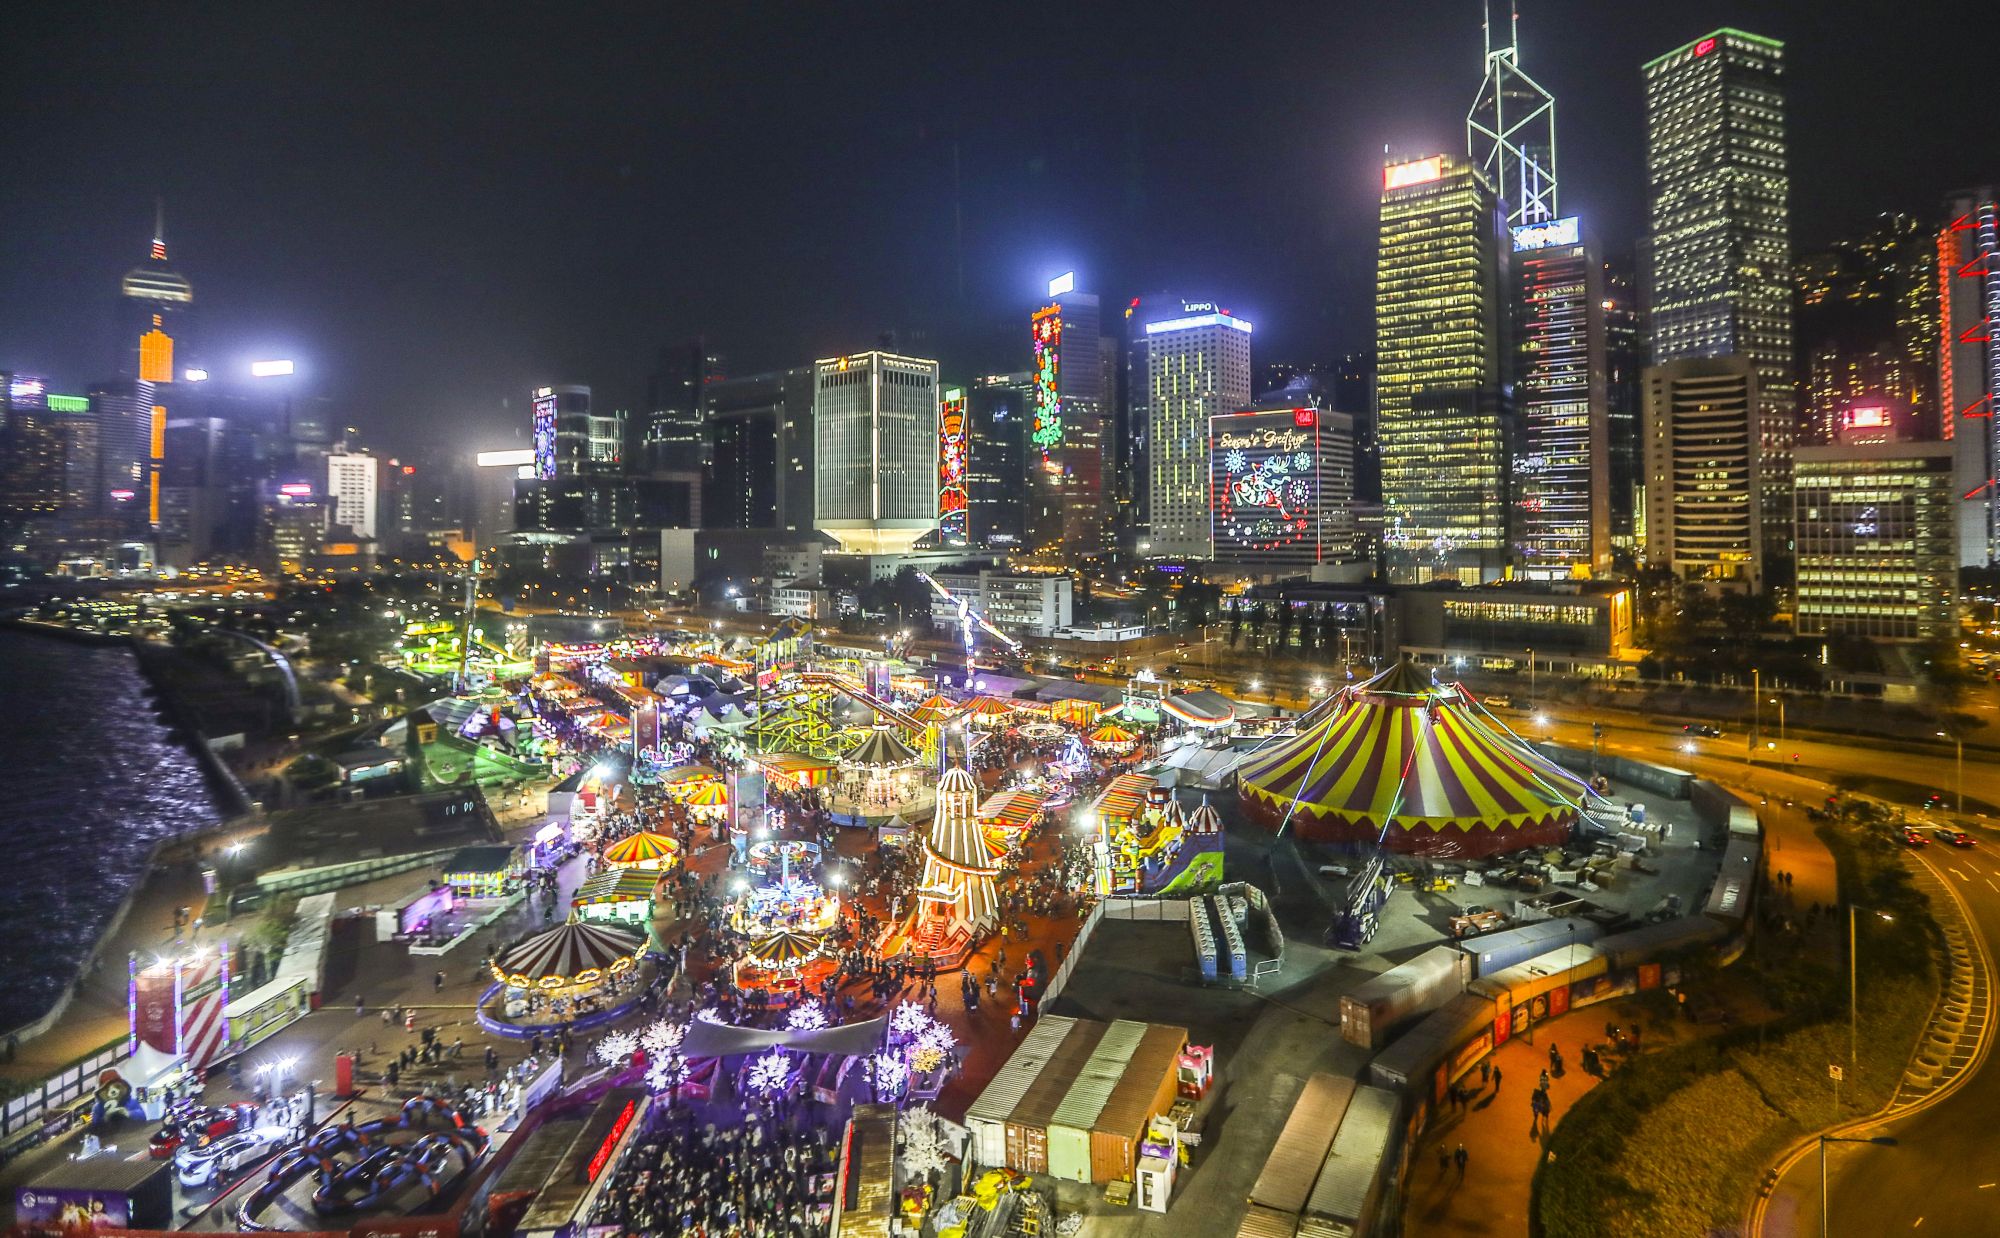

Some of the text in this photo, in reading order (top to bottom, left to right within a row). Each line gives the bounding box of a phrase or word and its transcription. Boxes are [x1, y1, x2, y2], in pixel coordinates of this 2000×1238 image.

[1184, 303, 1212, 312] LIPPO
[1220, 428, 1308, 452] Season's Greetings
